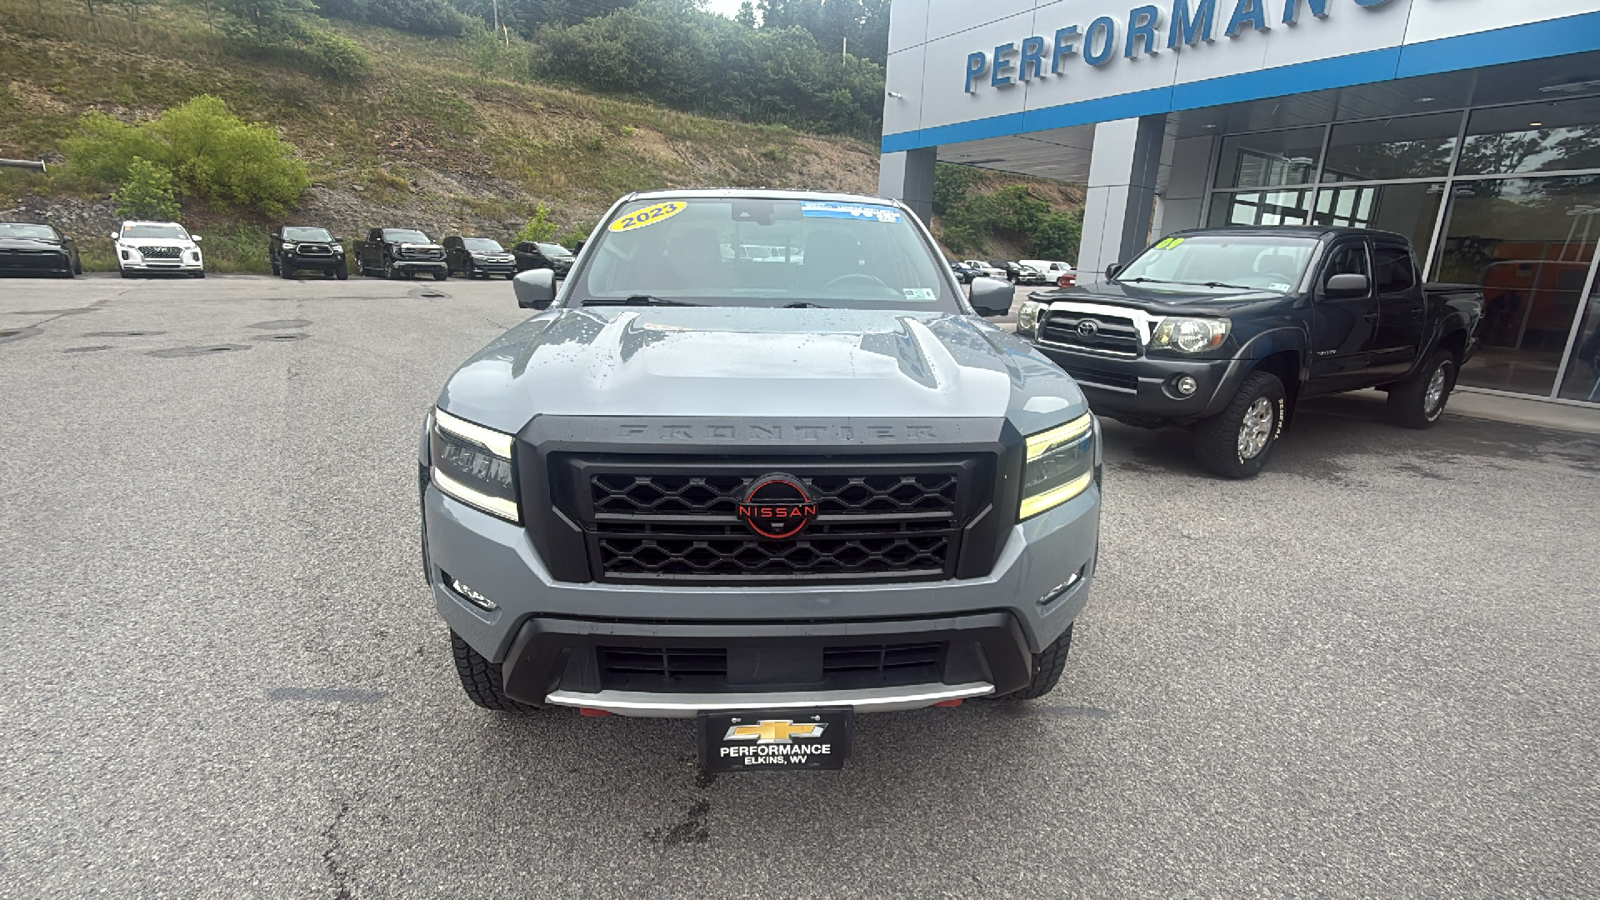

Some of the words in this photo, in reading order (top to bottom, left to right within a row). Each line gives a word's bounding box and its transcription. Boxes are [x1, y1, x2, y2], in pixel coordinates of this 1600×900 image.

[964, 0, 1396, 94] PERFORMA
[621, 203, 678, 228] 2023
[619, 424, 938, 441] FRONTIER
[738, 504, 817, 518] NISSAN
[720, 744, 831, 758] PERFORMANCE
[744, 755, 787, 765] ELKINS,
[789, 755, 808, 764] WV
